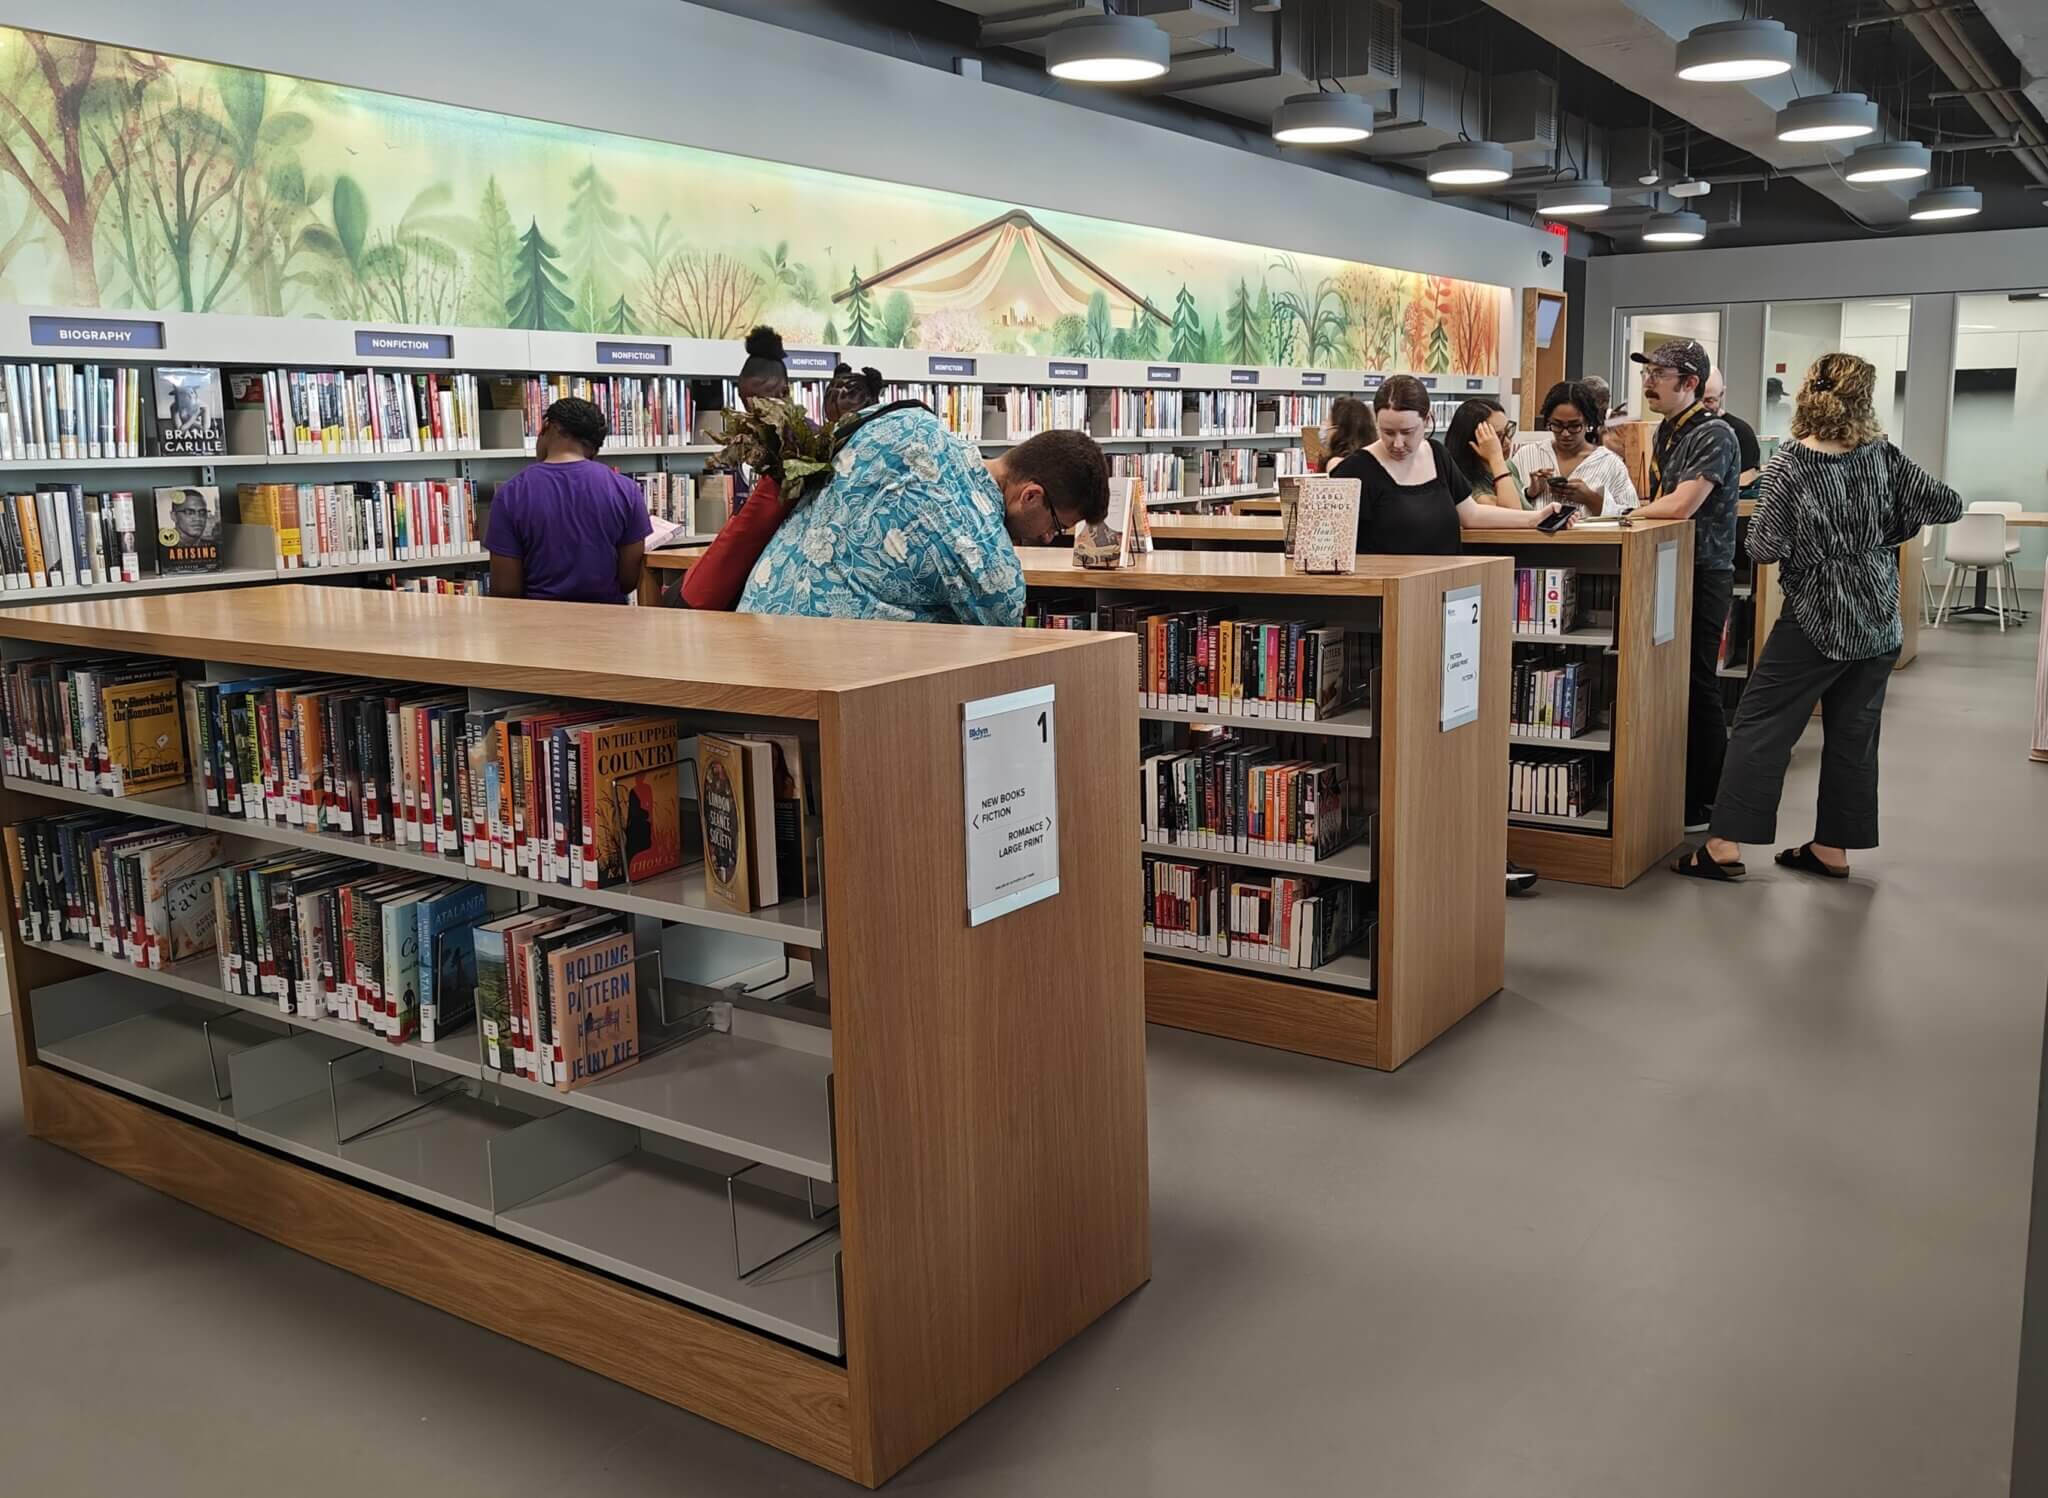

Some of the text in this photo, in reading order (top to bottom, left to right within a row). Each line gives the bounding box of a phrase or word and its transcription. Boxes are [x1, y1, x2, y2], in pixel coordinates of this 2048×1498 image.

[59, 329, 132, 341] BIOGRAPHY
[371, 338, 430, 350] NONFICTION
[611, 351, 657, 361] NONFICTION
[791, 358, 828, 367] NONFICTION
[164, 429, 220, 440] BRANDI
[164, 441, 224, 453] CARLILE
[168, 546, 217, 560] ARISING
[1471, 602, 1478, 625] 2
[597, 725, 677, 751] IN THE UPPER
[1037, 711, 1048, 743] 1
[598, 743, 677, 776] COUNTRY
[552, 735, 562, 812] CHARLES SOULE
[708, 791, 730, 813] LONDON
[981, 787, 1026, 809] NEW BOOKS
[710, 810, 731, 832] SEANCE
[981, 806, 1012, 824] FICTION
[710, 828, 733, 851] SOCIETY
[1008, 820, 1044, 841] ROMANCE
[998, 834, 1044, 858] LARGE PRINT
[631, 853, 675, 873] THOMAS
[178, 879, 197, 895] The
[162, 881, 213, 921] Favo
[435, 893, 486, 926] ATALANTA
[565, 944, 629, 985] HOLDING
[568, 973, 631, 1015] PATTERN
[613, 1039, 633, 1064] XIE
